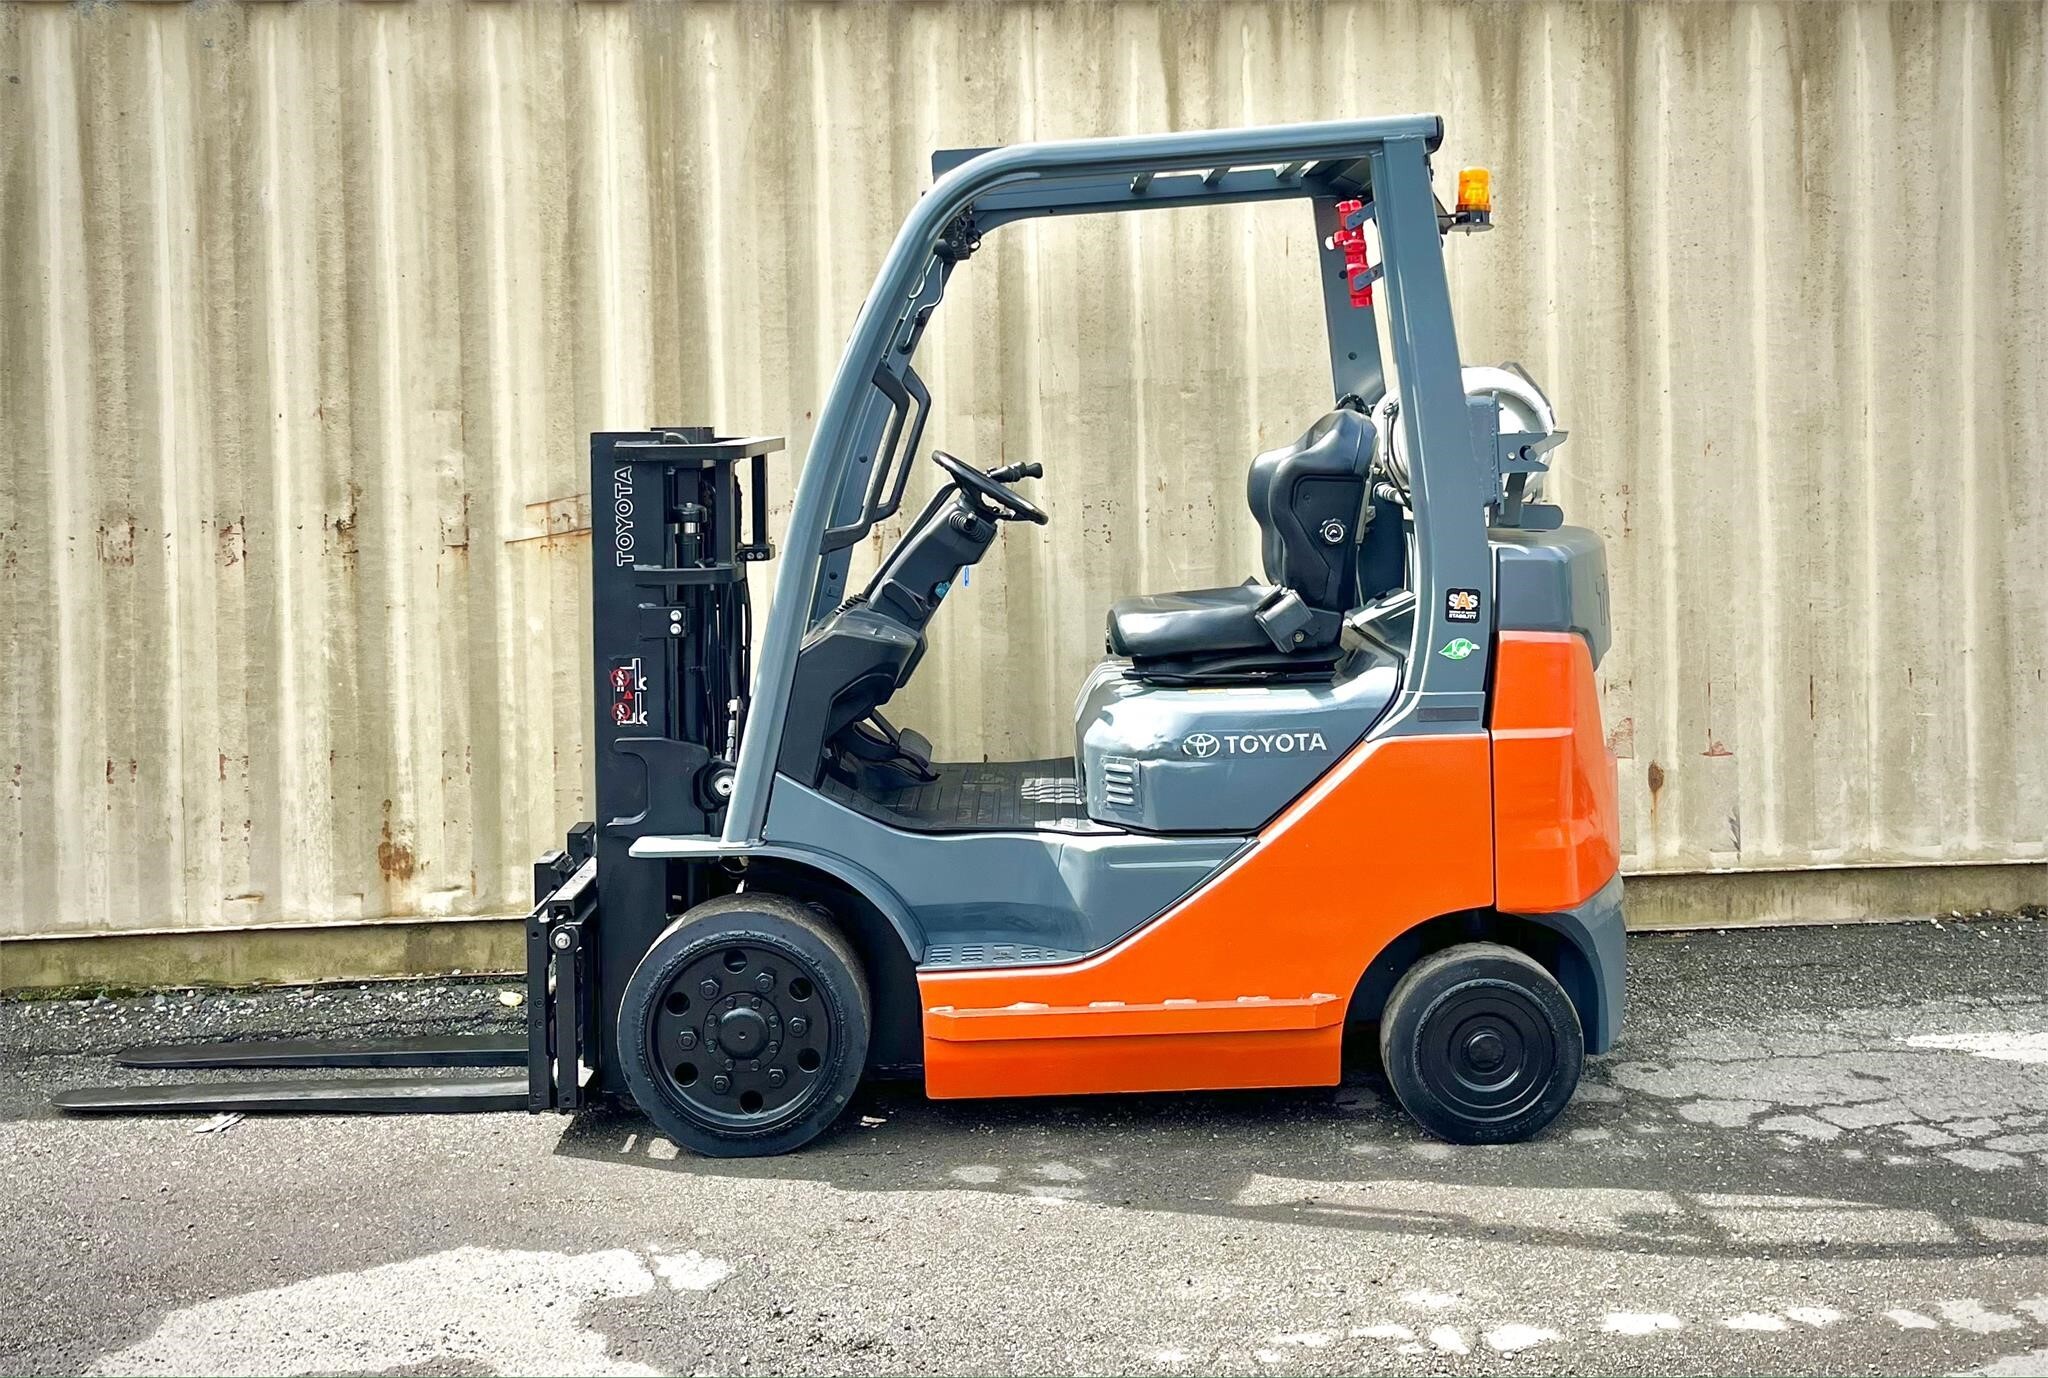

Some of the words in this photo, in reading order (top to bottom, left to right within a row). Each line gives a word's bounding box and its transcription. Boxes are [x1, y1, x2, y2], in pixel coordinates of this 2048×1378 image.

[614, 465, 635, 567] TOYOTA
[1448, 591, 1478, 610] SAS
[1223, 733, 1328, 754] TOYOTA
